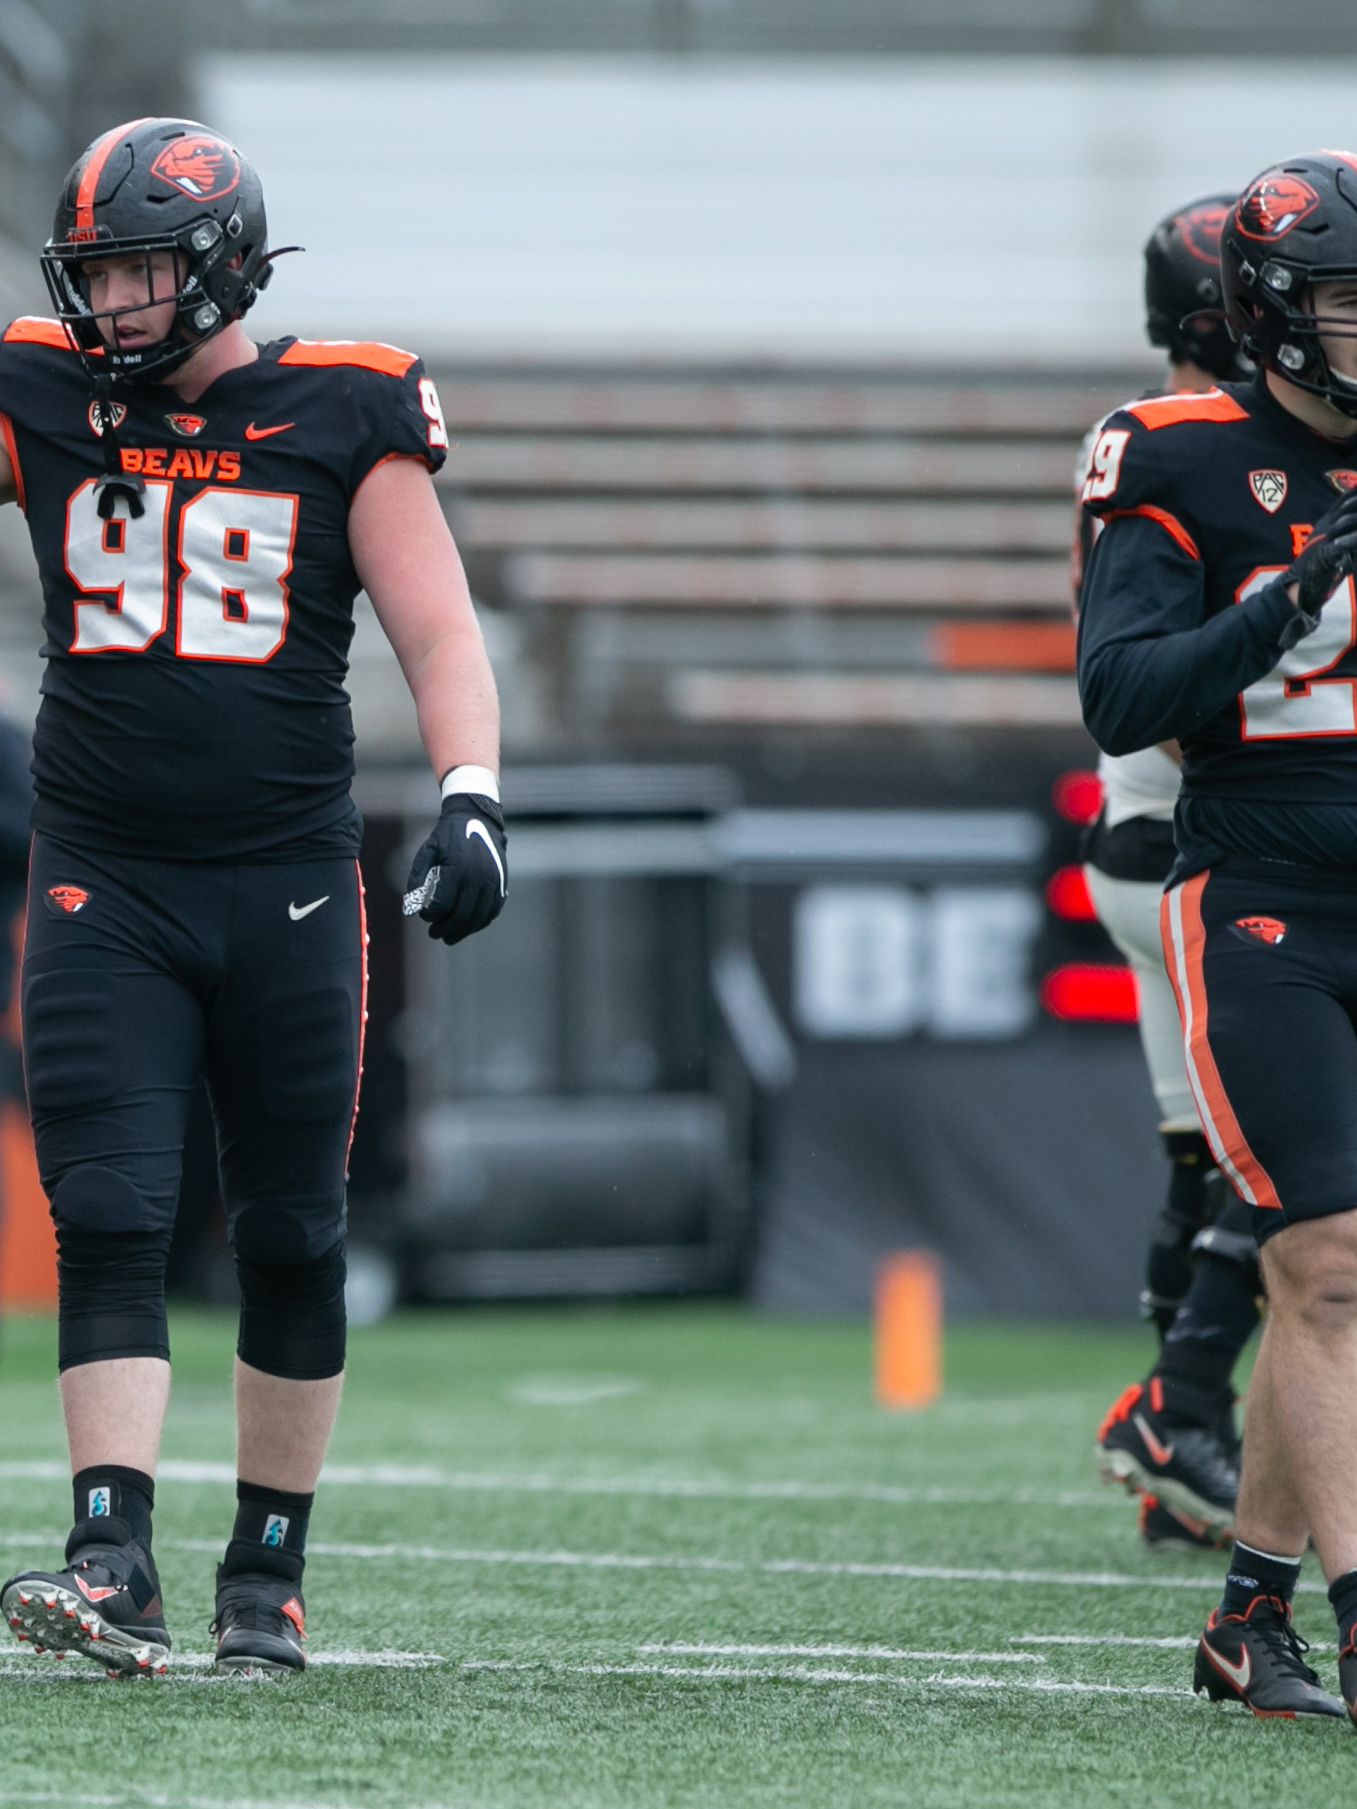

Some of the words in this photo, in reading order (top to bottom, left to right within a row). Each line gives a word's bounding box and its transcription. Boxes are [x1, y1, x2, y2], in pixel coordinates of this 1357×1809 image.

[417, 377, 450, 451] 9
[119, 448, 241, 481] BEAVS
[1261, 487, 1279, 503] 12
[63, 477, 300, 663] 98
